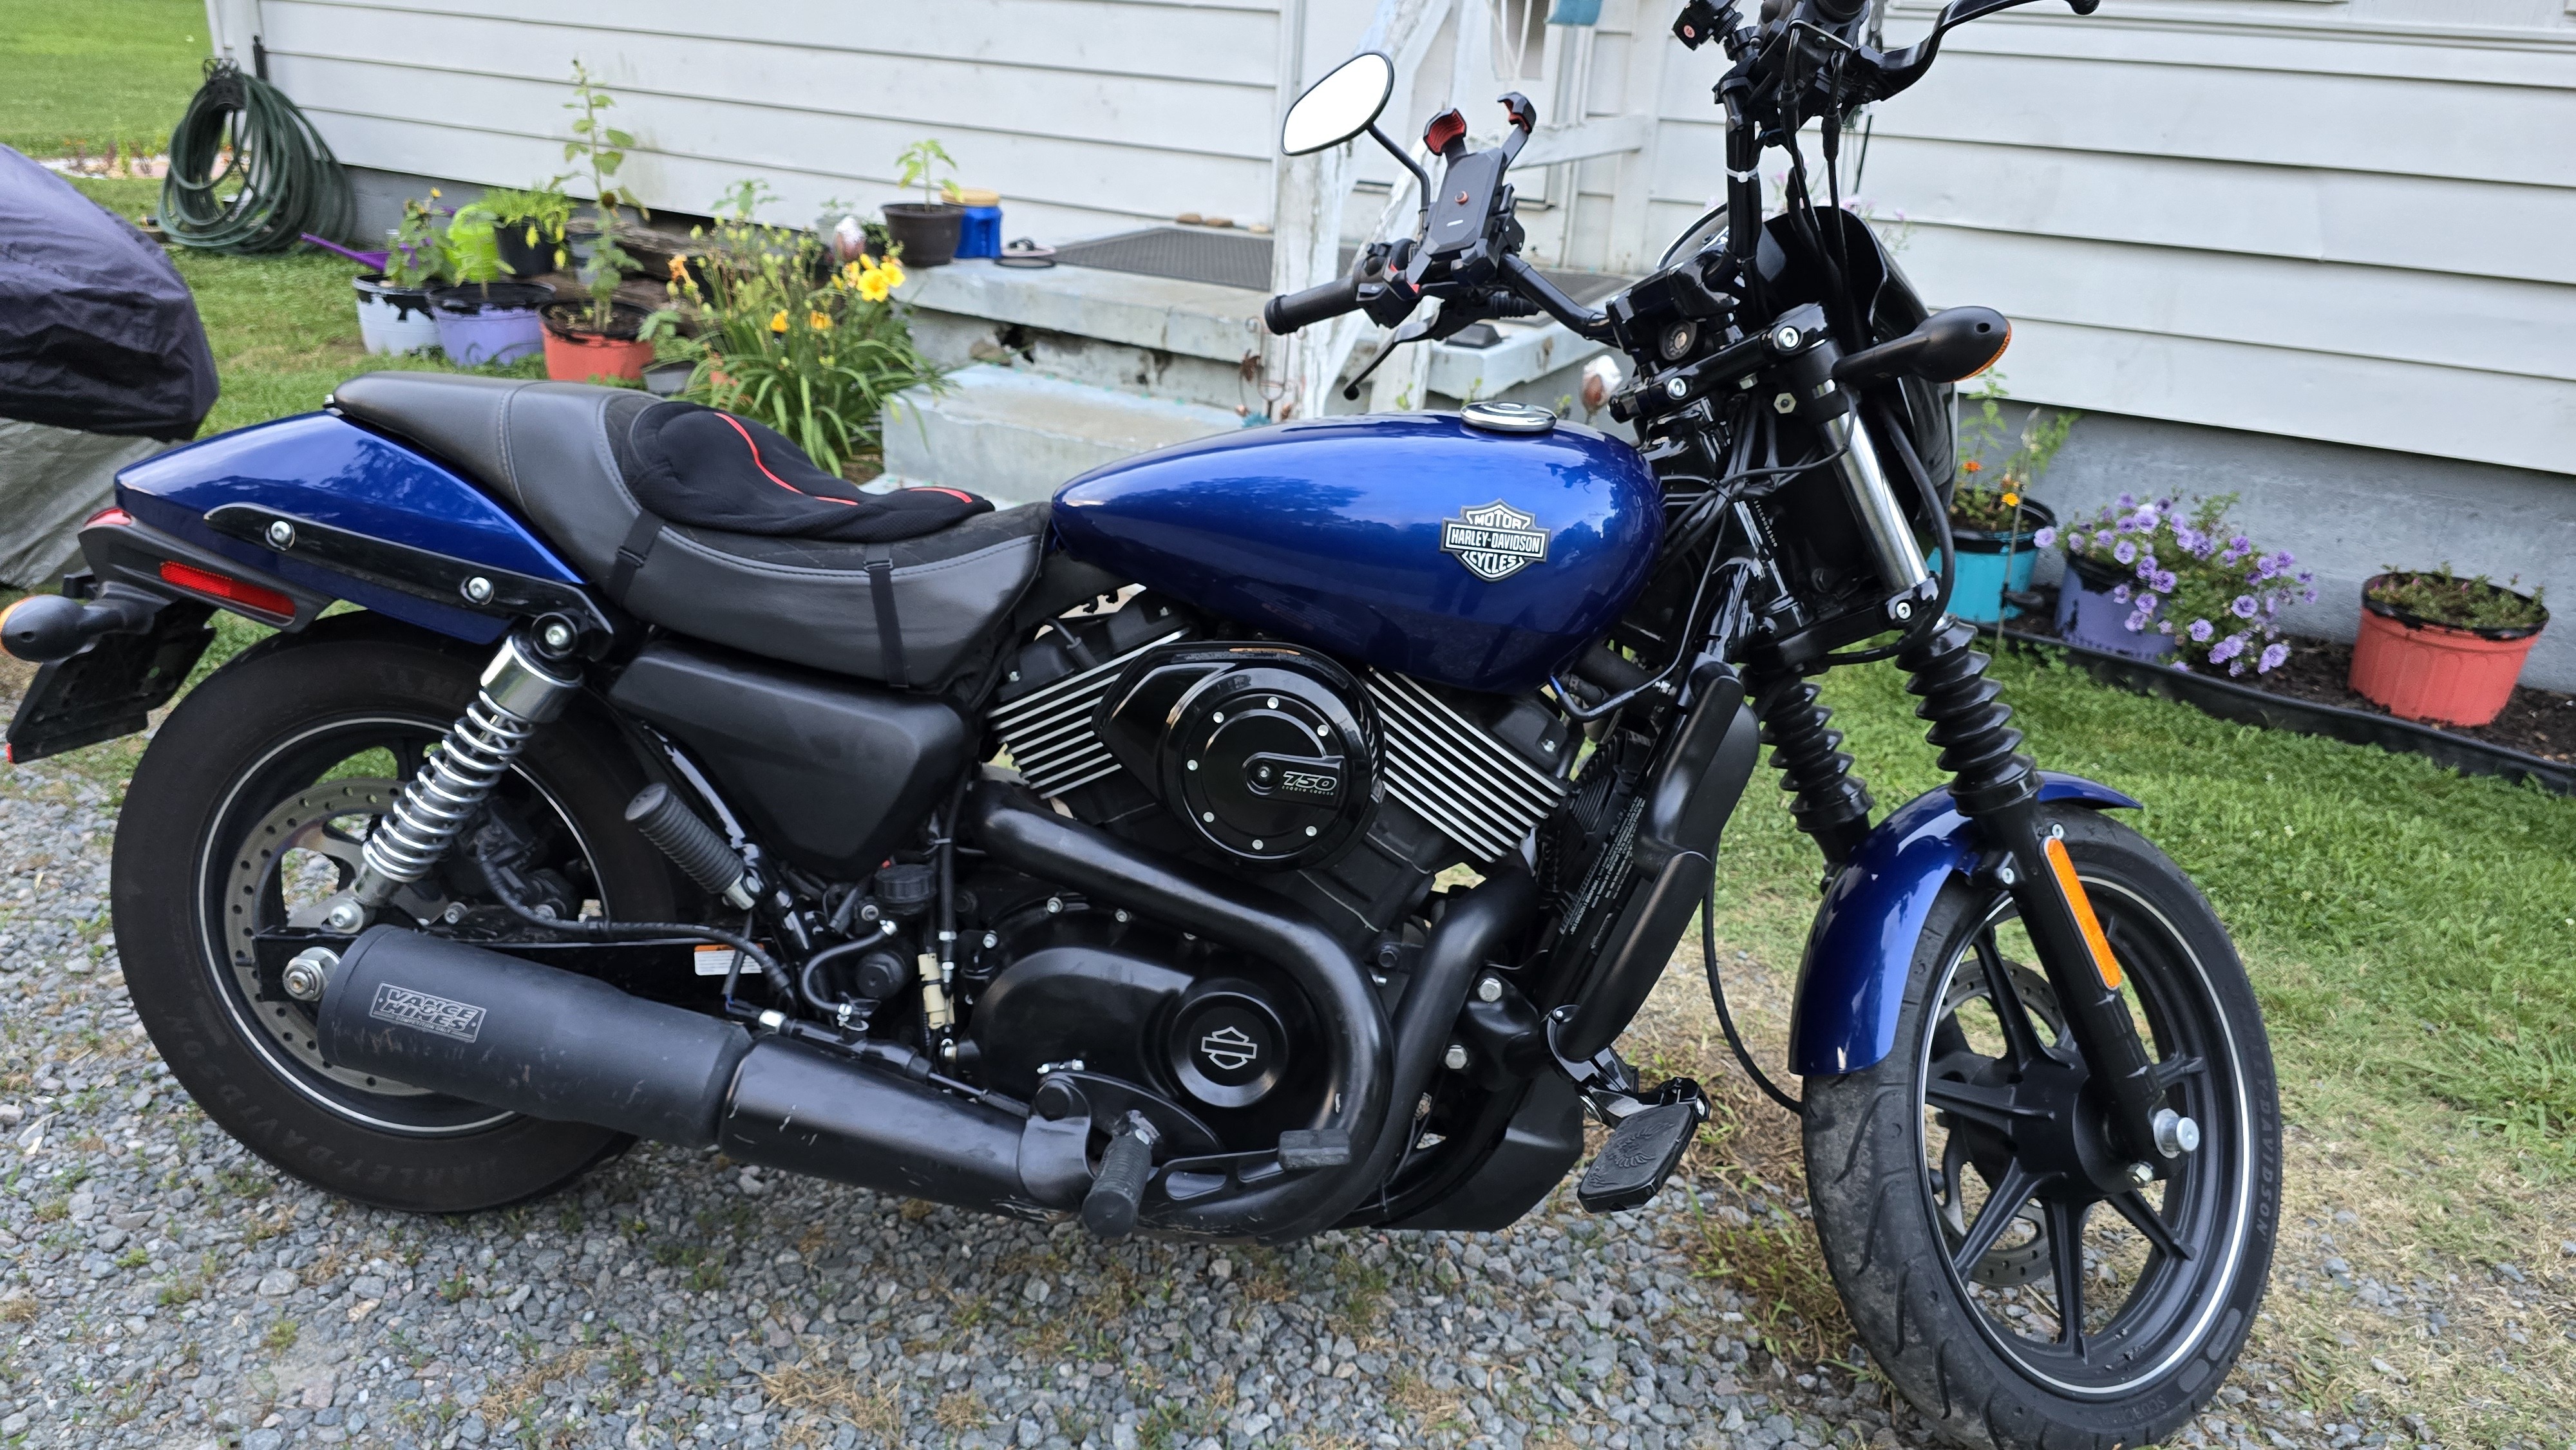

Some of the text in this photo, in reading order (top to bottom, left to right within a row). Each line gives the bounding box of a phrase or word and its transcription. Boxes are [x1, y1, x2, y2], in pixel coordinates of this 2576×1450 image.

[1474, 509, 1522, 530] MOTOR
[1451, 529, 1540, 552] HARLEY-DAVIDSON
[1469, 551, 1517, 574] CYCLES
[1283, 771, 1337, 791] 750
[386, 988, 478, 1017] VANCE
[380, 1000, 468, 1031] HINES
